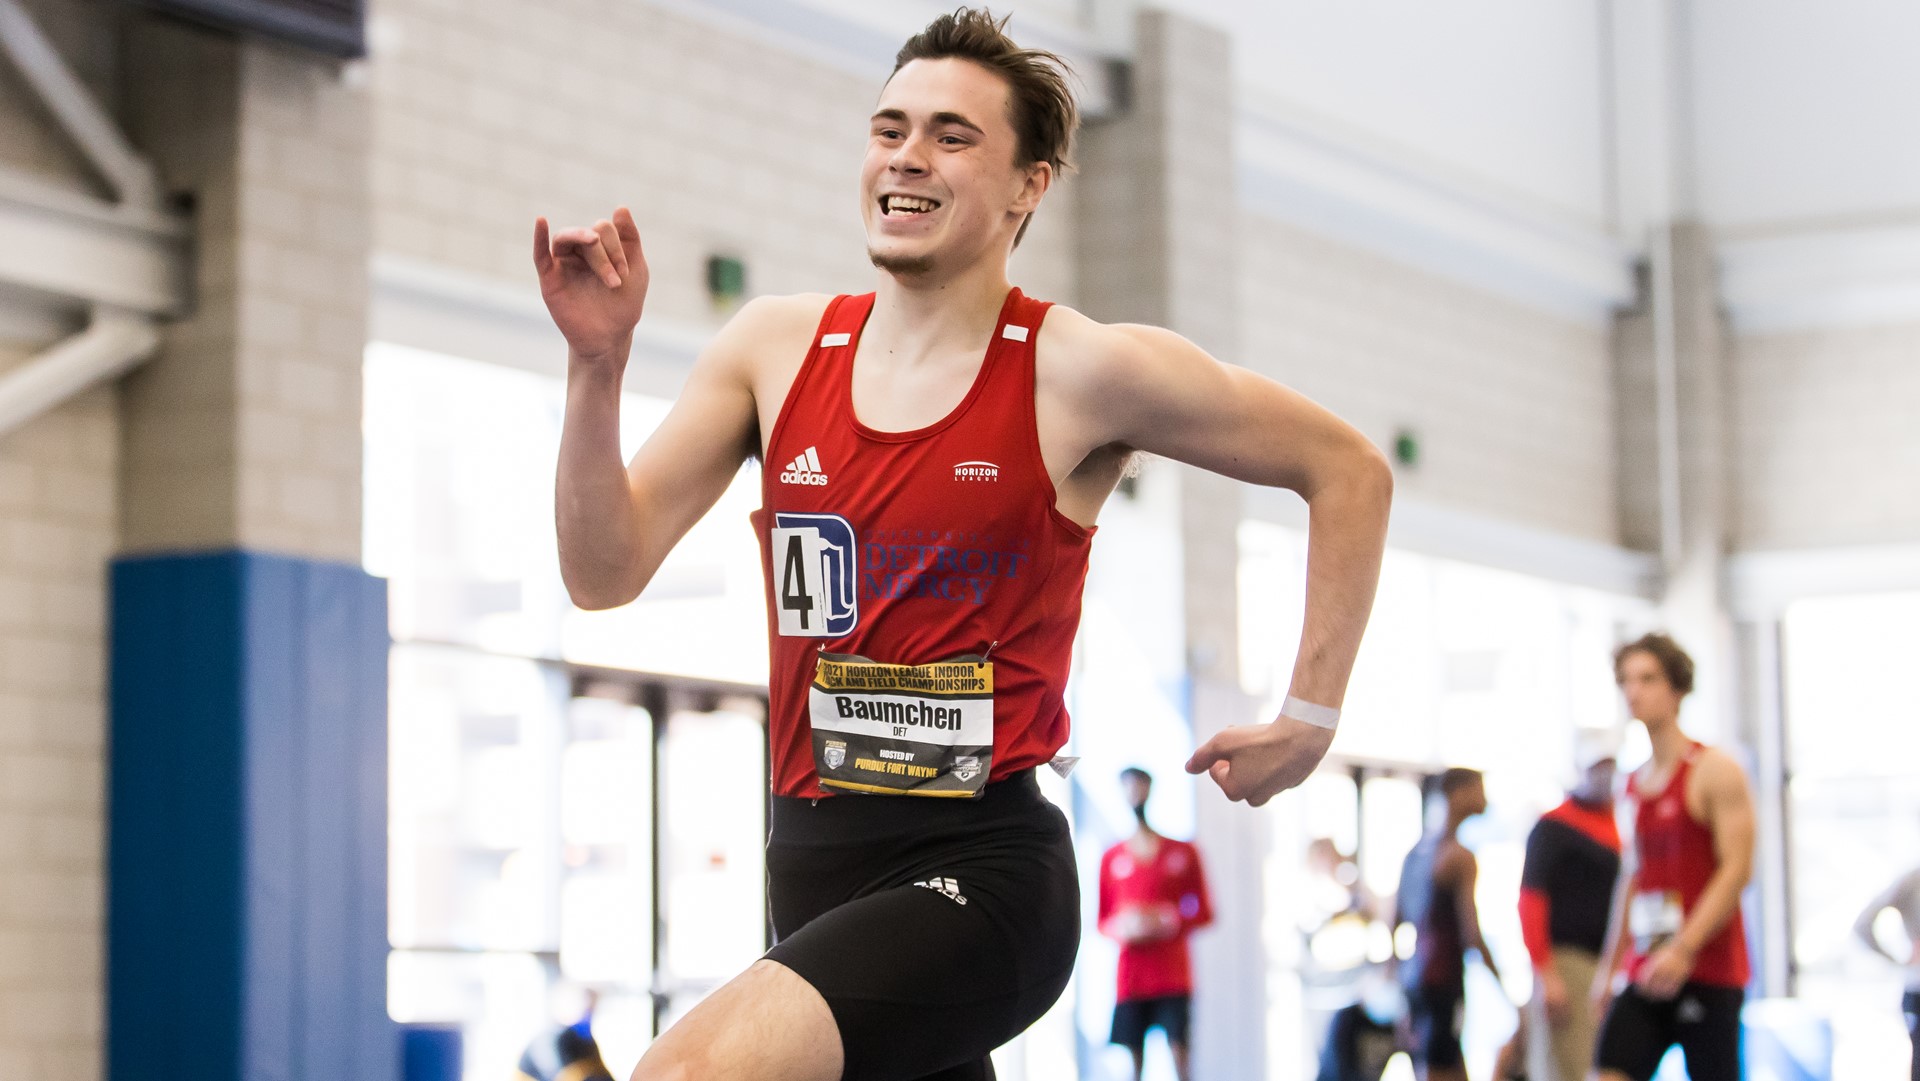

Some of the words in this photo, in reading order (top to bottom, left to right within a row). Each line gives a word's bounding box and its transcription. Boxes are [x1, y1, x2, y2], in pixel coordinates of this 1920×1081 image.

[780, 469, 828, 486] adidas
[955, 467, 998, 477] HORIZON
[863, 543, 1029, 579] DETROIT
[782, 535, 813, 630] 4
[863, 573, 993, 605] MERCY
[846, 665, 892, 678] HORIZON
[893, 666, 931, 678] LEAGUE
[934, 665, 975, 678] INDOOR
[846, 677, 867, 687] AND
[868, 677, 896, 688] FIELD
[898, 677, 985, 691] CHAMPIONSHIPS
[835, 696, 962, 730] Baumchen
[880, 749, 905, 761] HOSTED
[905, 752, 915, 762] BY
[854, 757, 887, 773] PURDUE
[886, 762, 907, 775] FORT
[907, 765, 939, 778] WAYNE
